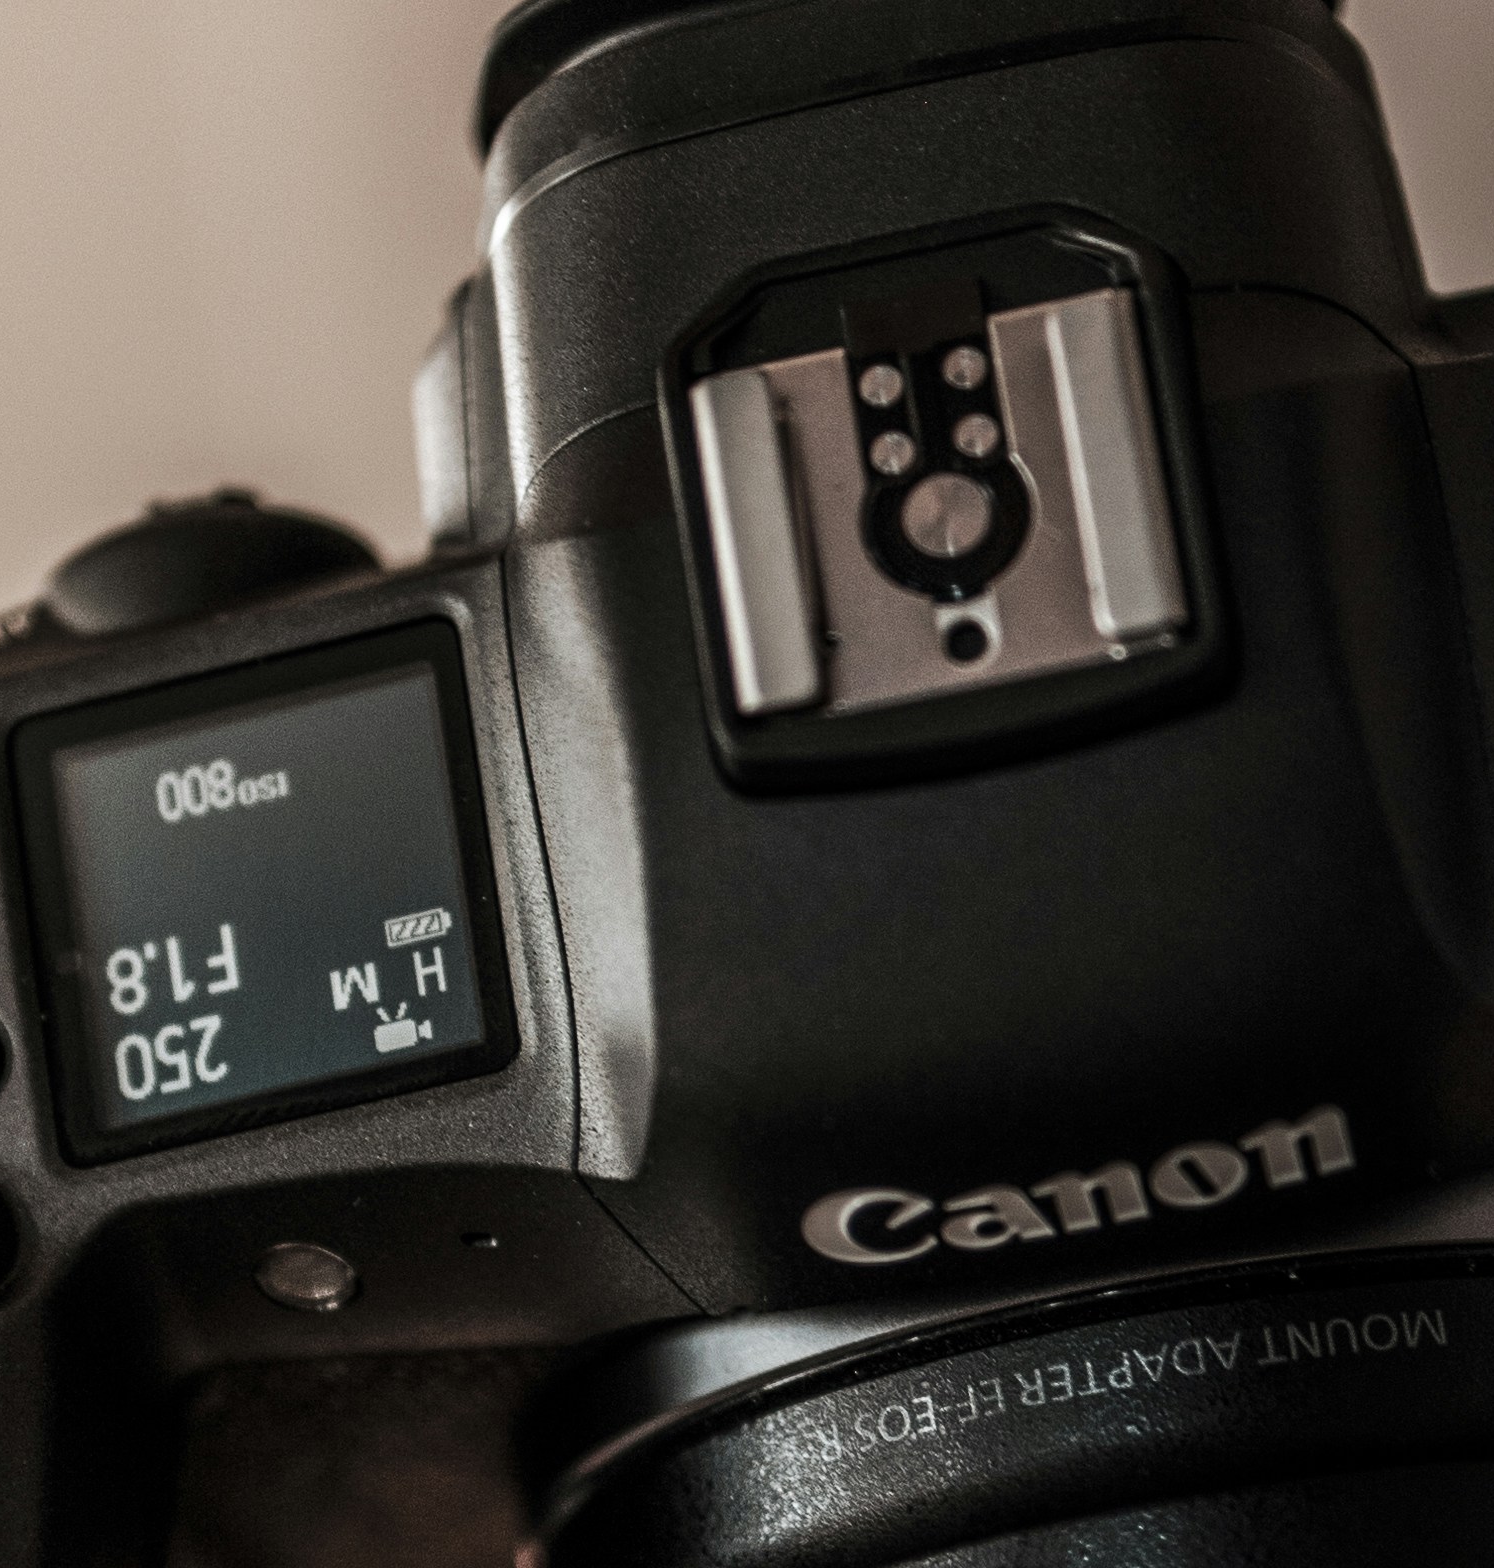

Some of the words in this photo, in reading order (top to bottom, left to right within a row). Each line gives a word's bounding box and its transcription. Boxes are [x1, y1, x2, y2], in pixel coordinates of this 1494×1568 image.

[329, 962, 380, 1011] M
[412, 946, 448, 997] H
[115, 1010, 229, 1101] 250
[802, 1103, 1356, 1265] Canon
[1013, 1330, 1241, 1408] ADAPTER
[1256, 1307, 1448, 1367] MOUNT
[852, 1374, 1007, 1450] EF-EOS
